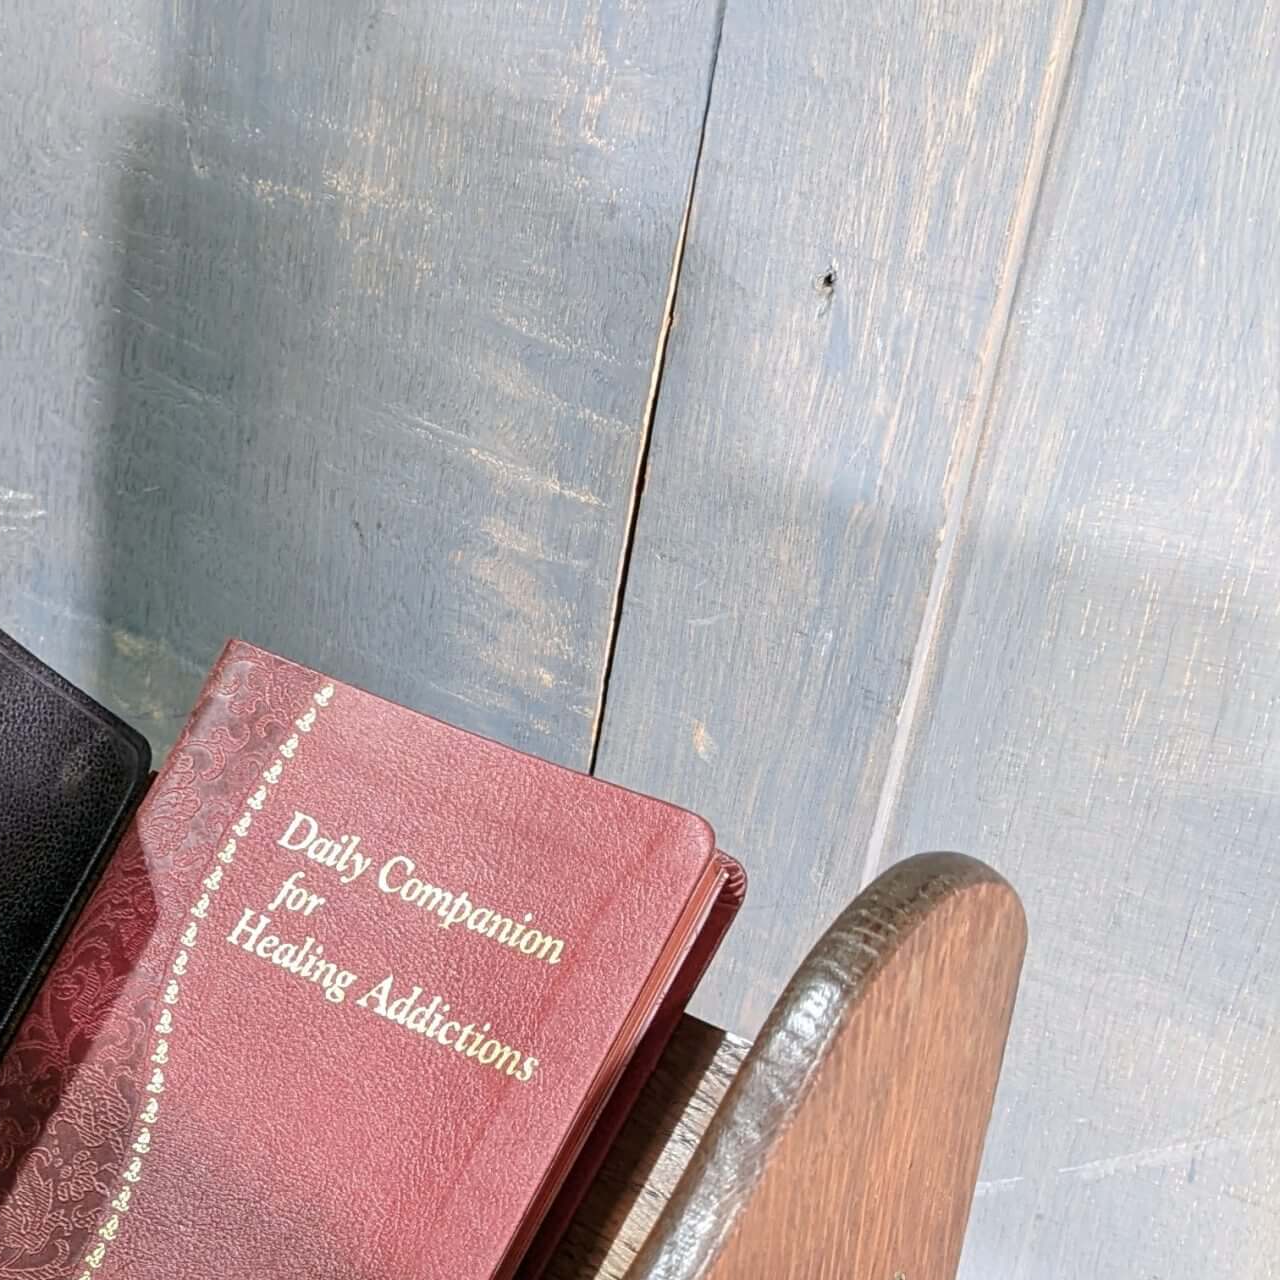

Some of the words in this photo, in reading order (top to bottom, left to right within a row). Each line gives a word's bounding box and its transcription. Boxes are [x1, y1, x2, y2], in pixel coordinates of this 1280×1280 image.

[268, 871, 326, 916] for
[277, 811, 372, 883] Daily
[378, 855, 565, 964] Companion
[226, 908, 357, 1003] Healing
[356, 974, 540, 1081] Addictions
